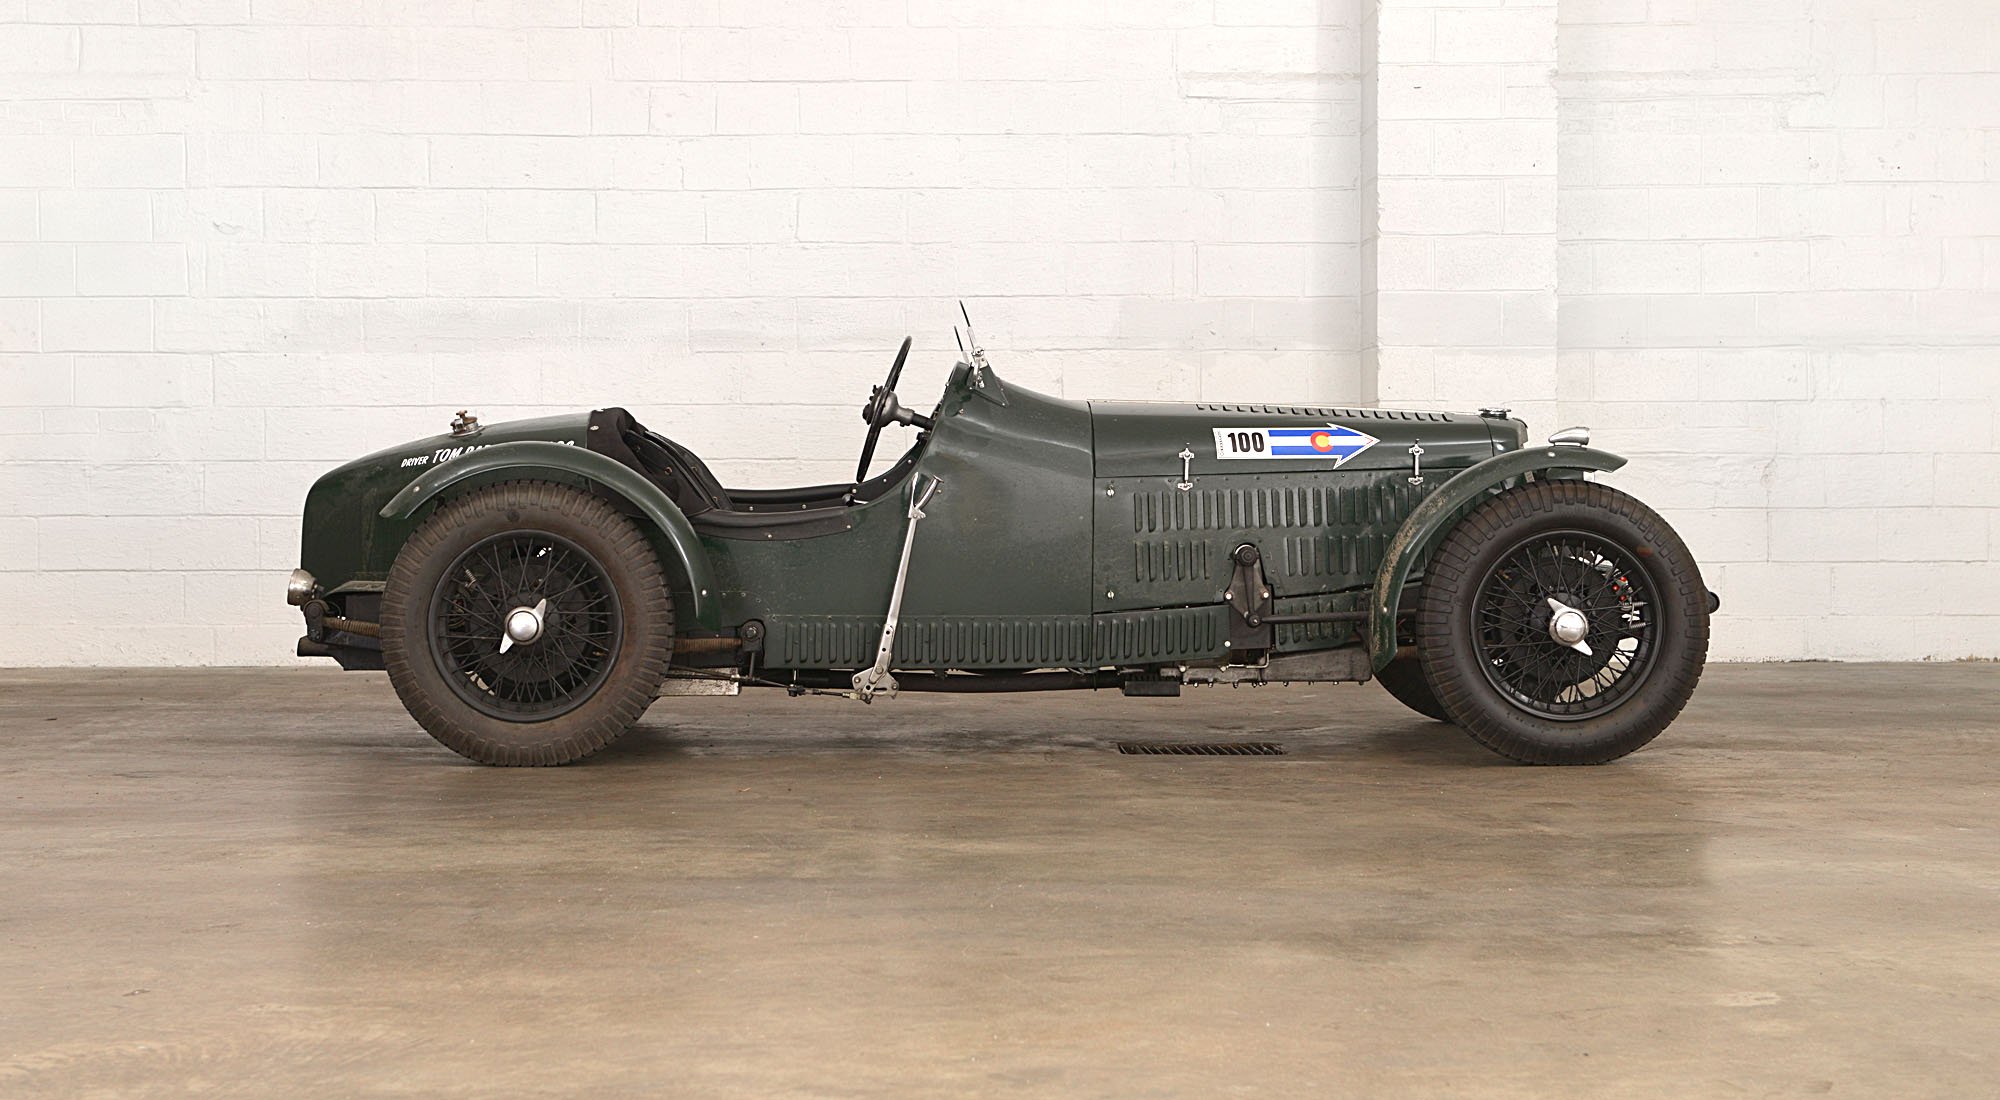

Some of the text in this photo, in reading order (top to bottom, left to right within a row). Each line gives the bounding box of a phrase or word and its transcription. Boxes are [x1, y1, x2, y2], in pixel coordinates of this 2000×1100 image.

[1227, 431, 1265, 453] 100
[400, 455, 429, 468] DRIVER
[432, 446, 464, 464] TOM
